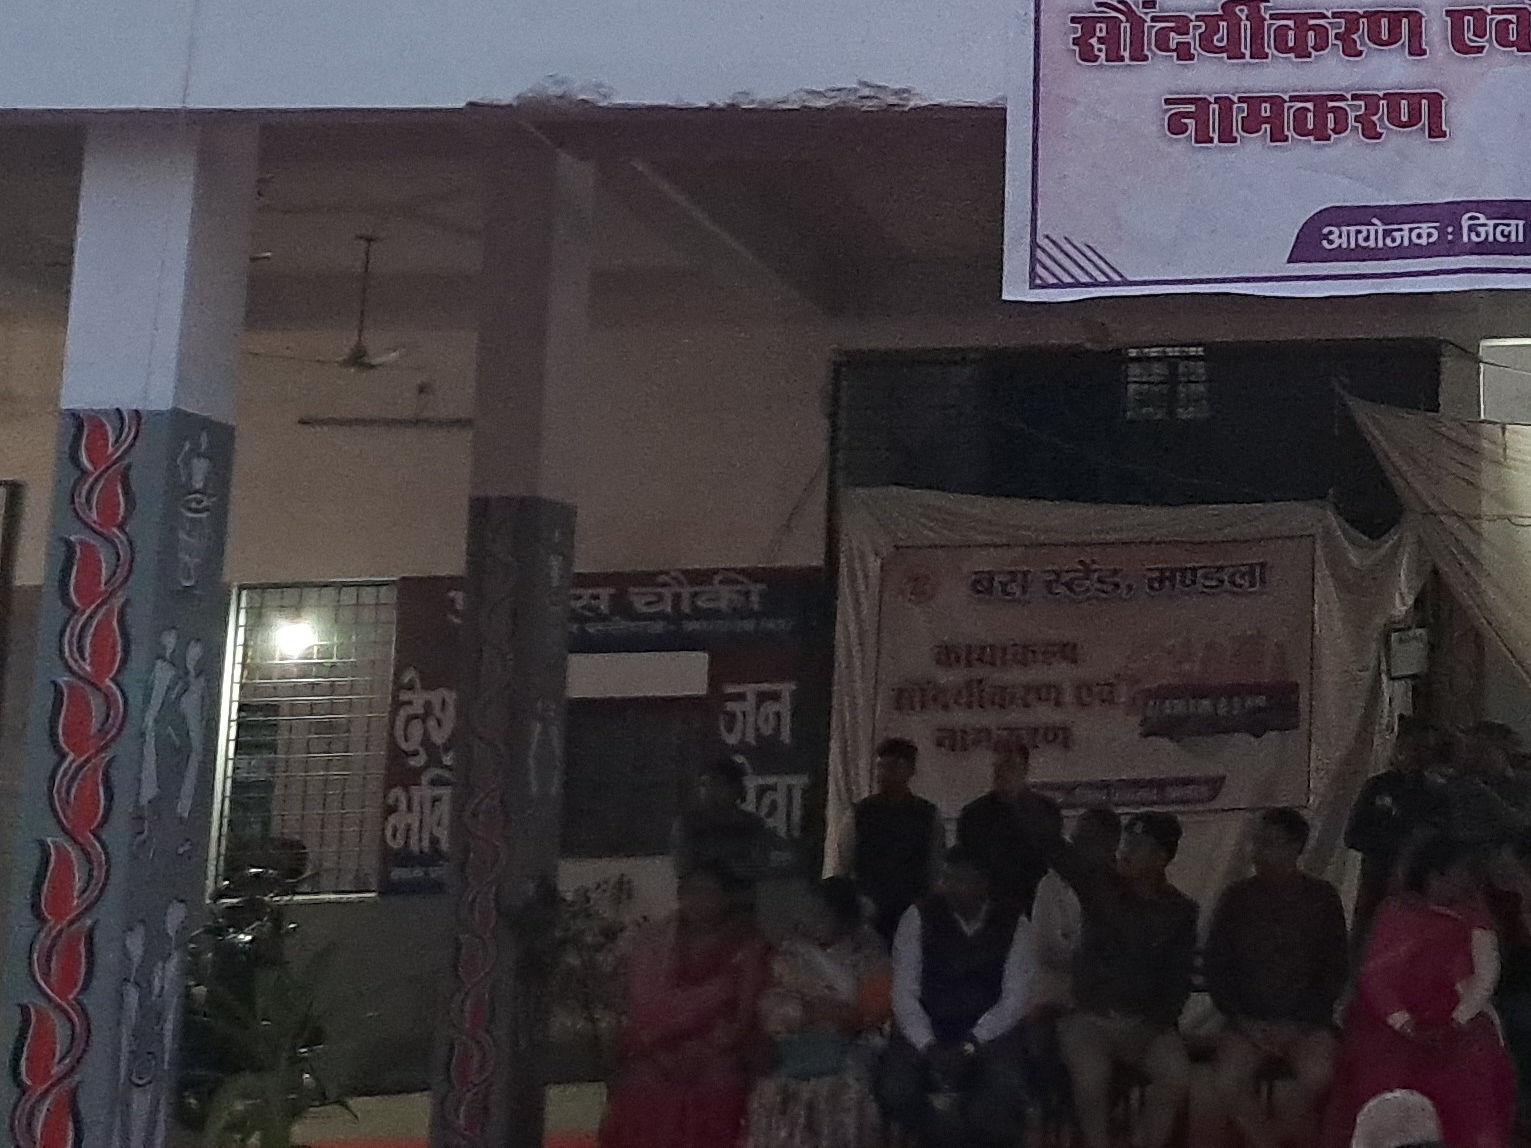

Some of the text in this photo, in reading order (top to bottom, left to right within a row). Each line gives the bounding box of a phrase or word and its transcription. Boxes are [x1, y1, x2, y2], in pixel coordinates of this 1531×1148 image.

[1163, 90, 1450, 145] नामकरण
[1320, 218, 1440, 250] आयोजक
[1460, 212, 1524, 244] जिला
[626, 568, 768, 614] चौकी
[969, 569, 1032, 599] बस
[1144, 560, 1269, 596] मण्डला
[719, 682, 798, 745] जन
